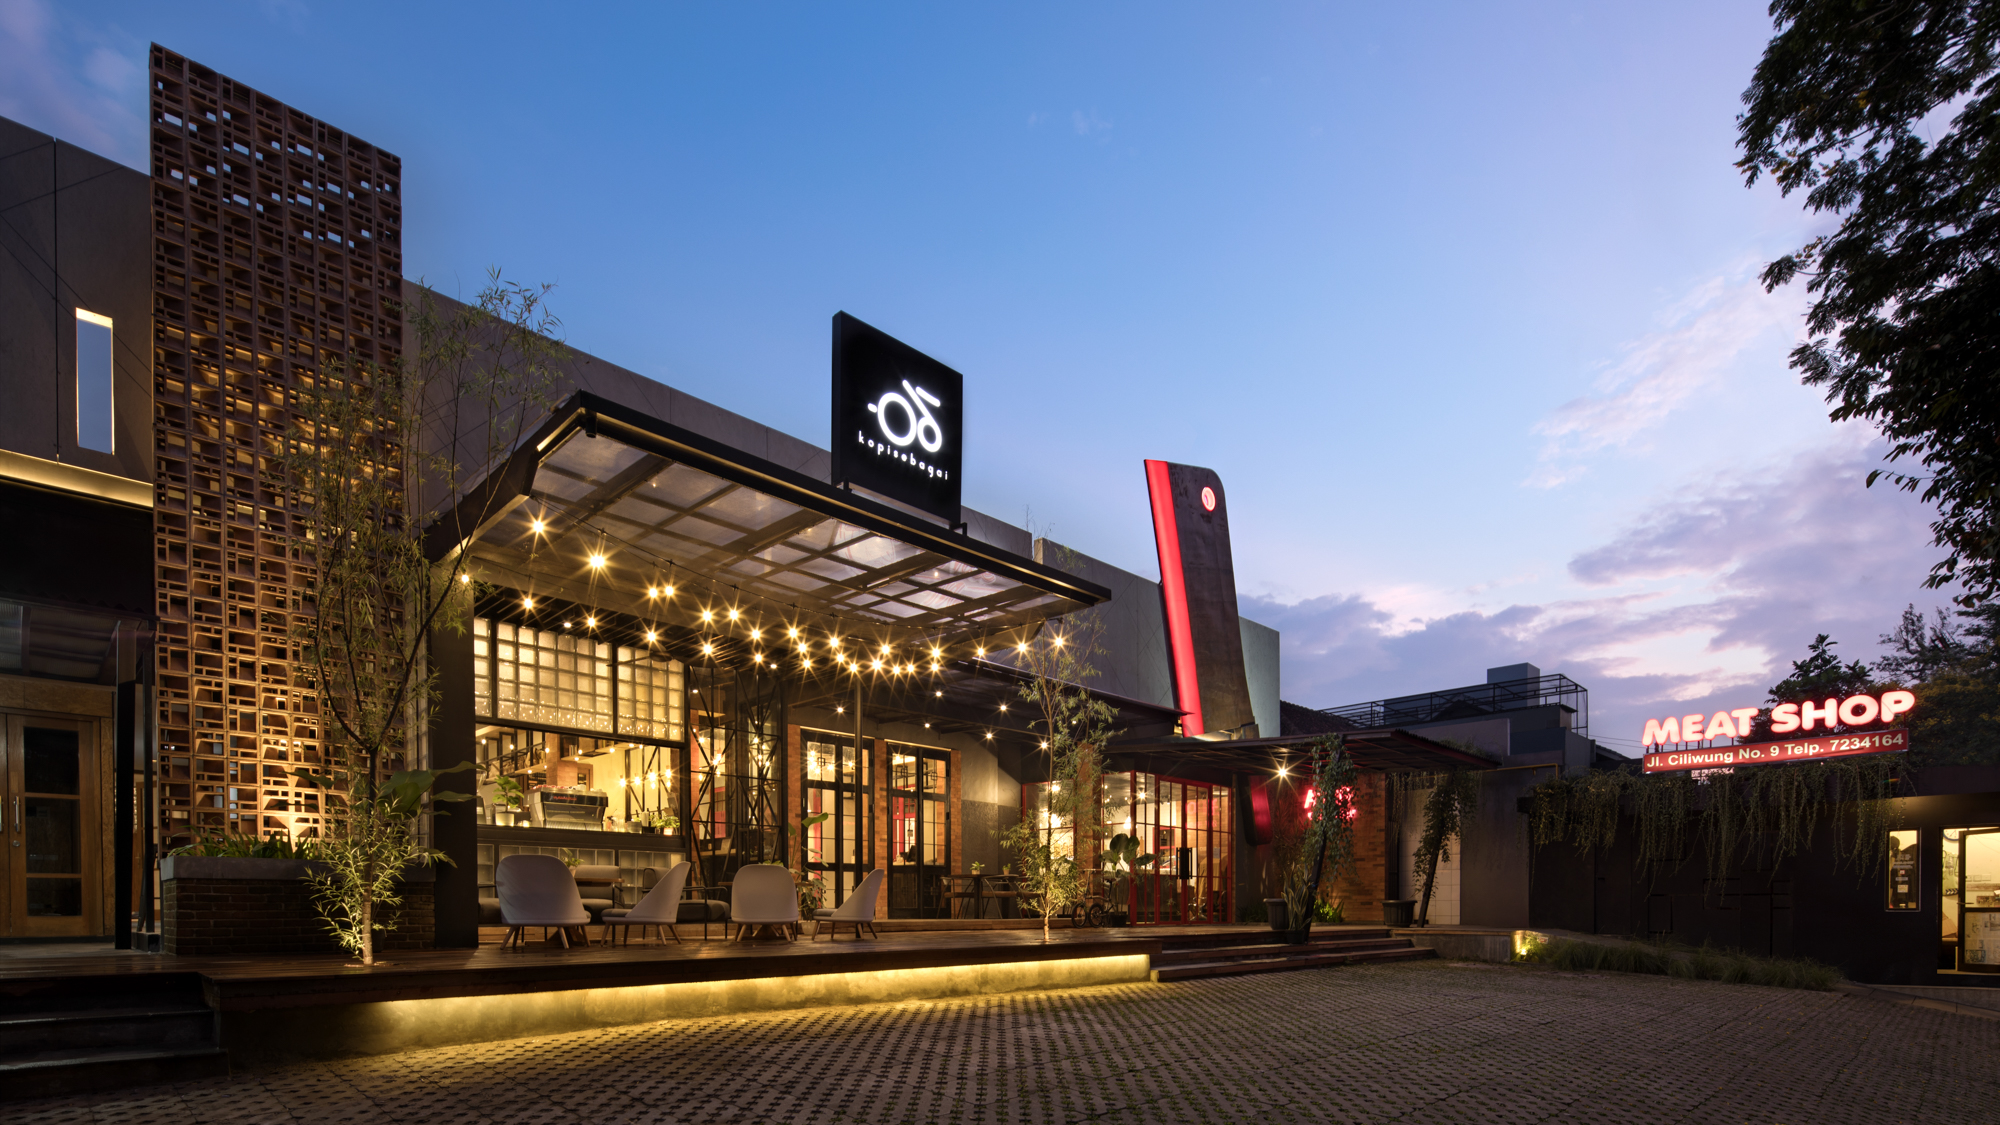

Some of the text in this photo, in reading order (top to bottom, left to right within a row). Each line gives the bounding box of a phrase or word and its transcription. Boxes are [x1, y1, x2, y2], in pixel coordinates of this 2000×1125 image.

[858, 430, 948, 480] kopisebagai
[1642, 690, 1916, 746] MEAT SHOP
[1646, 733, 1904, 768] Jl. Ciliwung No. 9 Telp. 7234164
